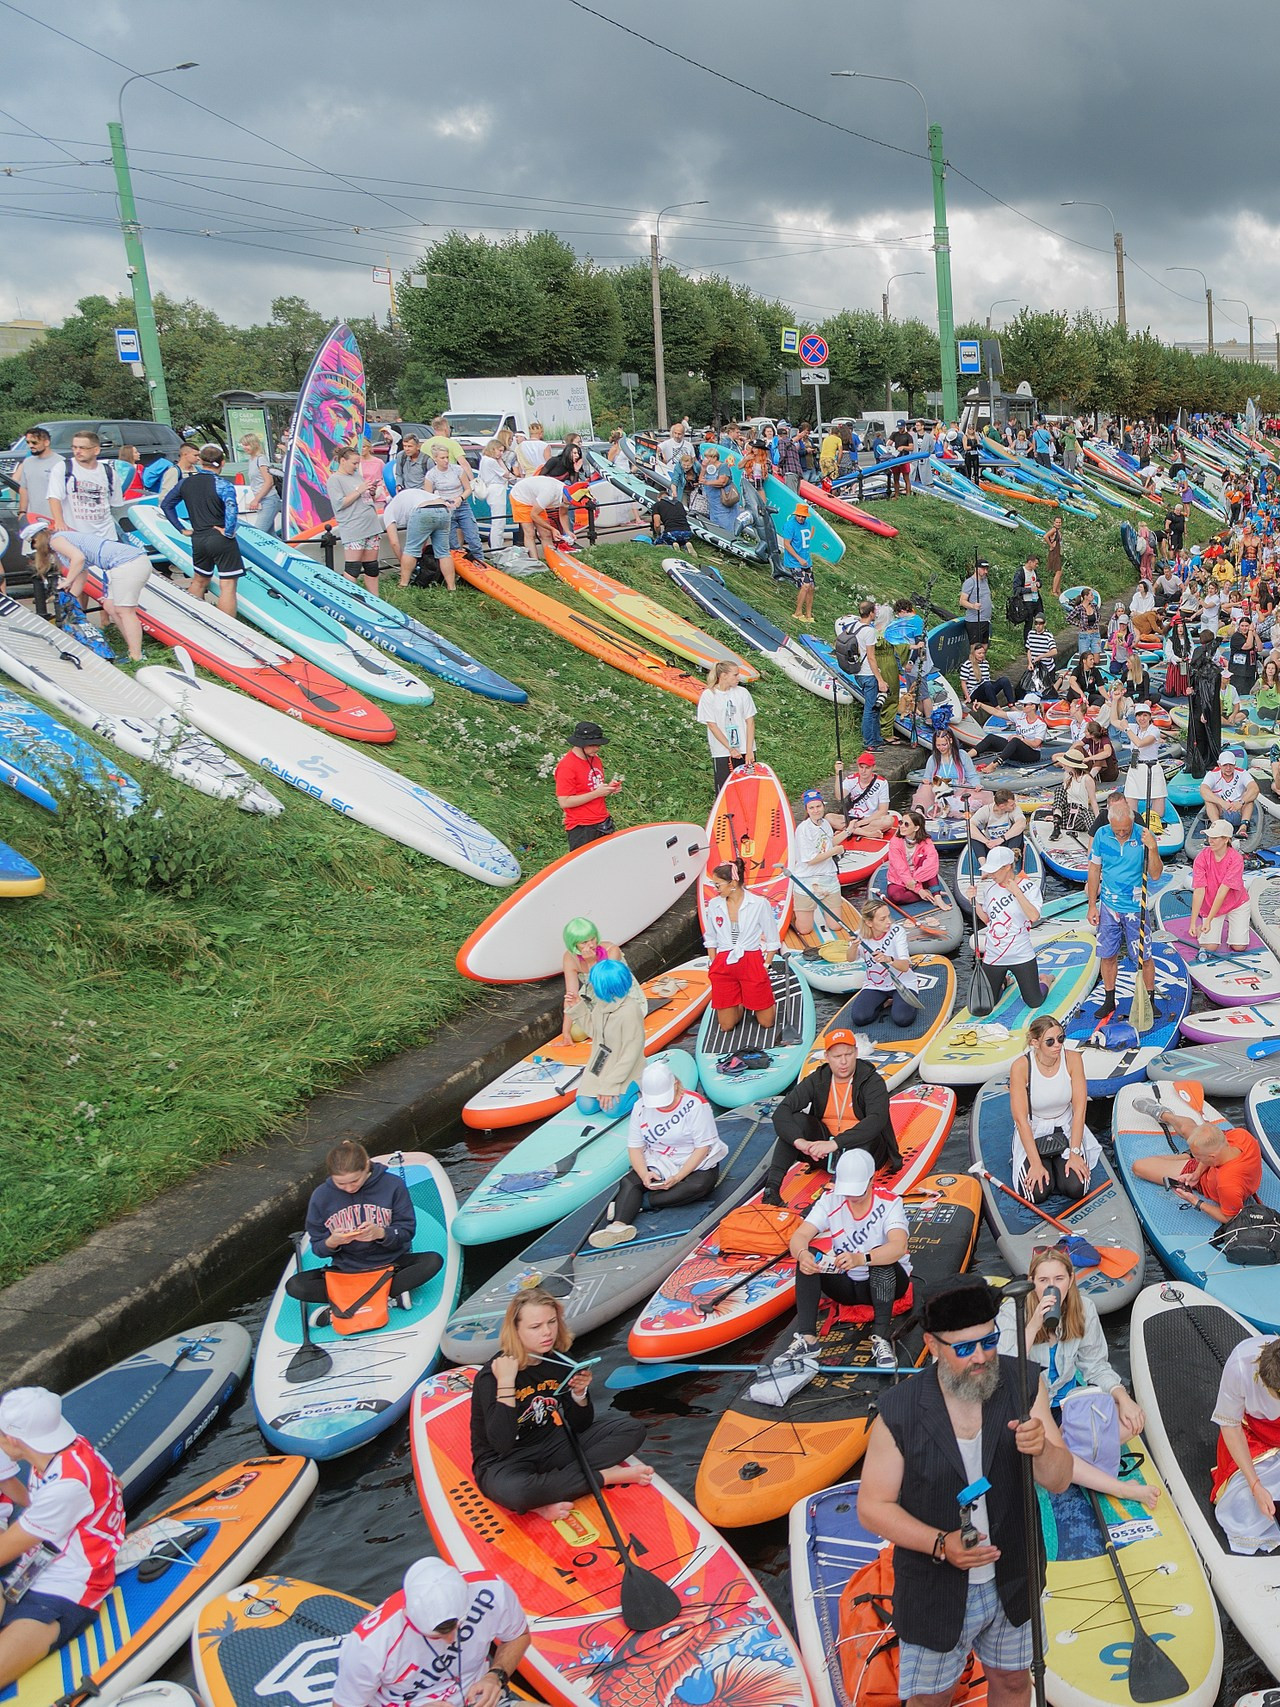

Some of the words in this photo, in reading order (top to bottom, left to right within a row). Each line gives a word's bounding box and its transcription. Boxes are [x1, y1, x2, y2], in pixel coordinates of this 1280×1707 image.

[320, 605, 347, 622] SUP
[354, 625, 398, 655] BOARD
[989, 881, 1034, 921] etlGrup
[642, 1099, 696, 1145] tlGroup
[832, 1203, 887, 1258] etlGrup
[1110, 1524, 1154, 1539] 05365
[390, 1587, 494, 1703] etlGroup
